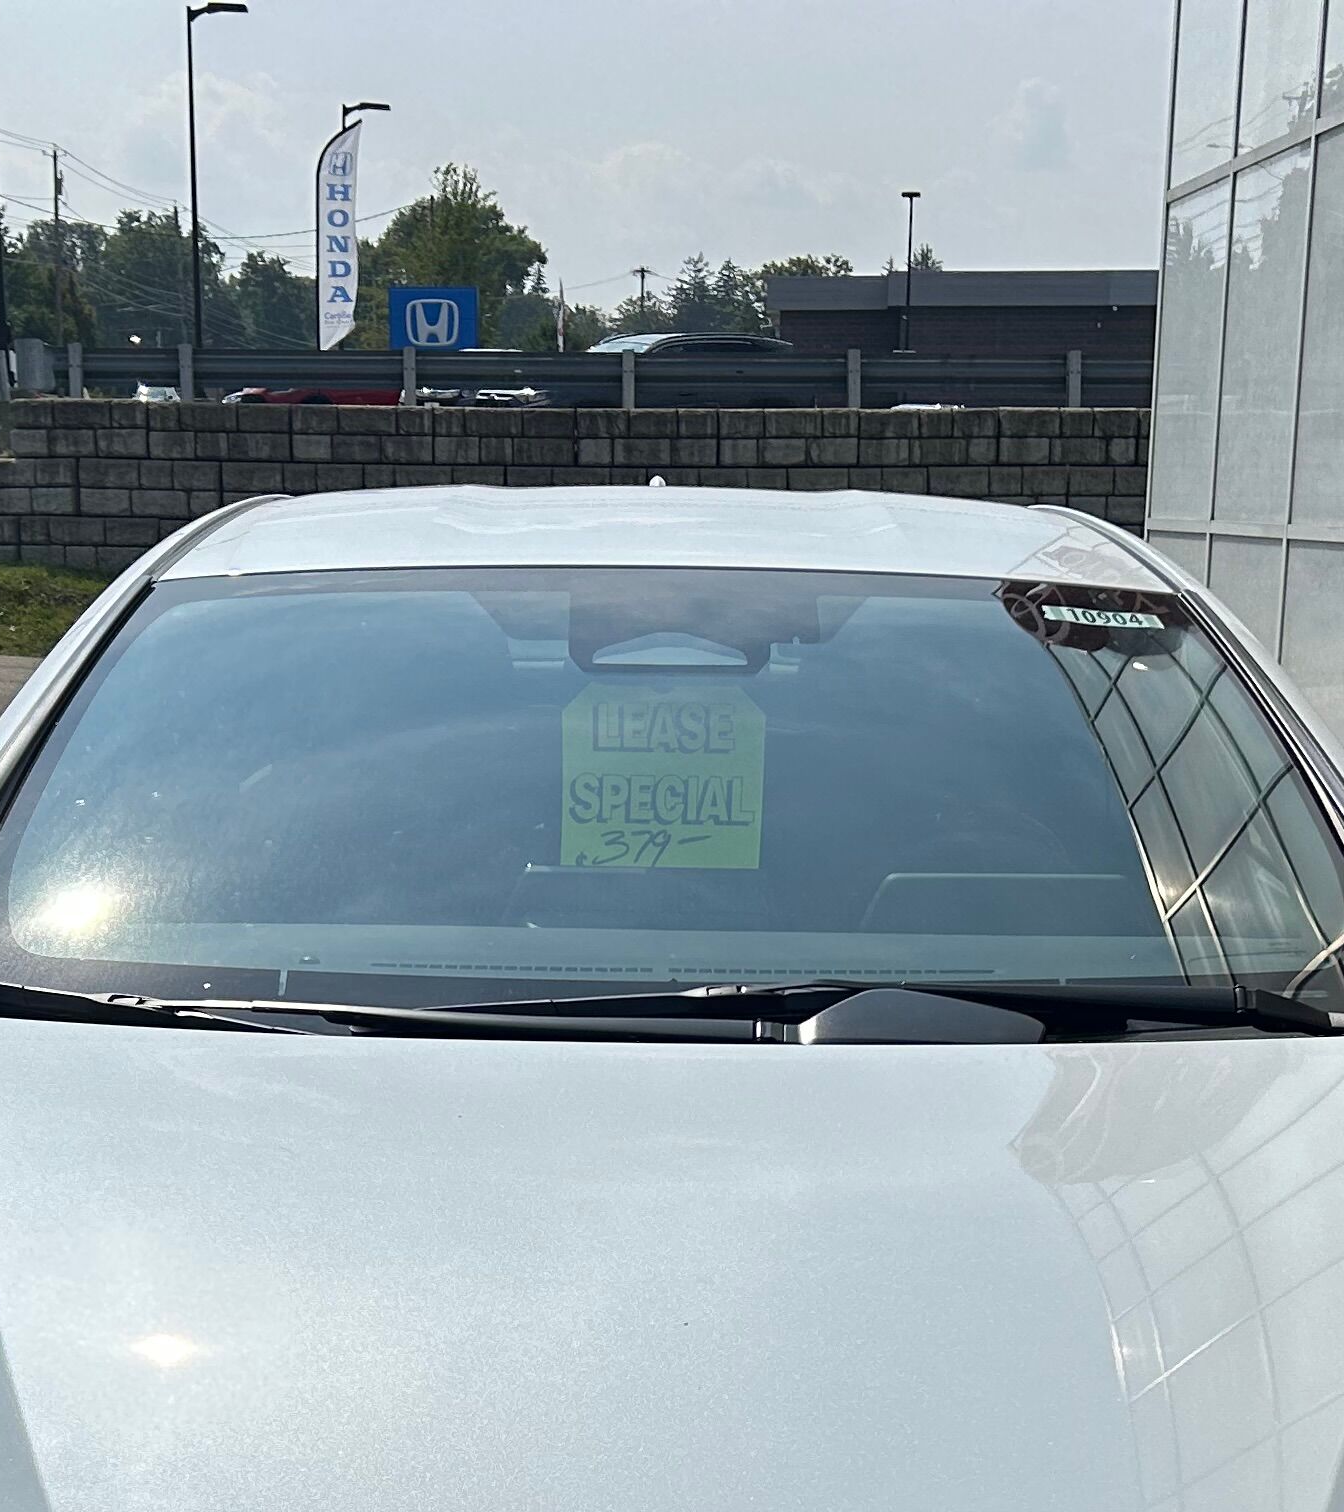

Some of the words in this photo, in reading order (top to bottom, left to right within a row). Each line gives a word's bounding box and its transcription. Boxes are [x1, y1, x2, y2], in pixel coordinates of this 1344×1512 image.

[325, 183, 354, 303] HONDA
[1066, 607, 1144, 626] 10904
[592, 701, 737, 754] LEASE
[569, 772, 756, 826] SPECIAL
